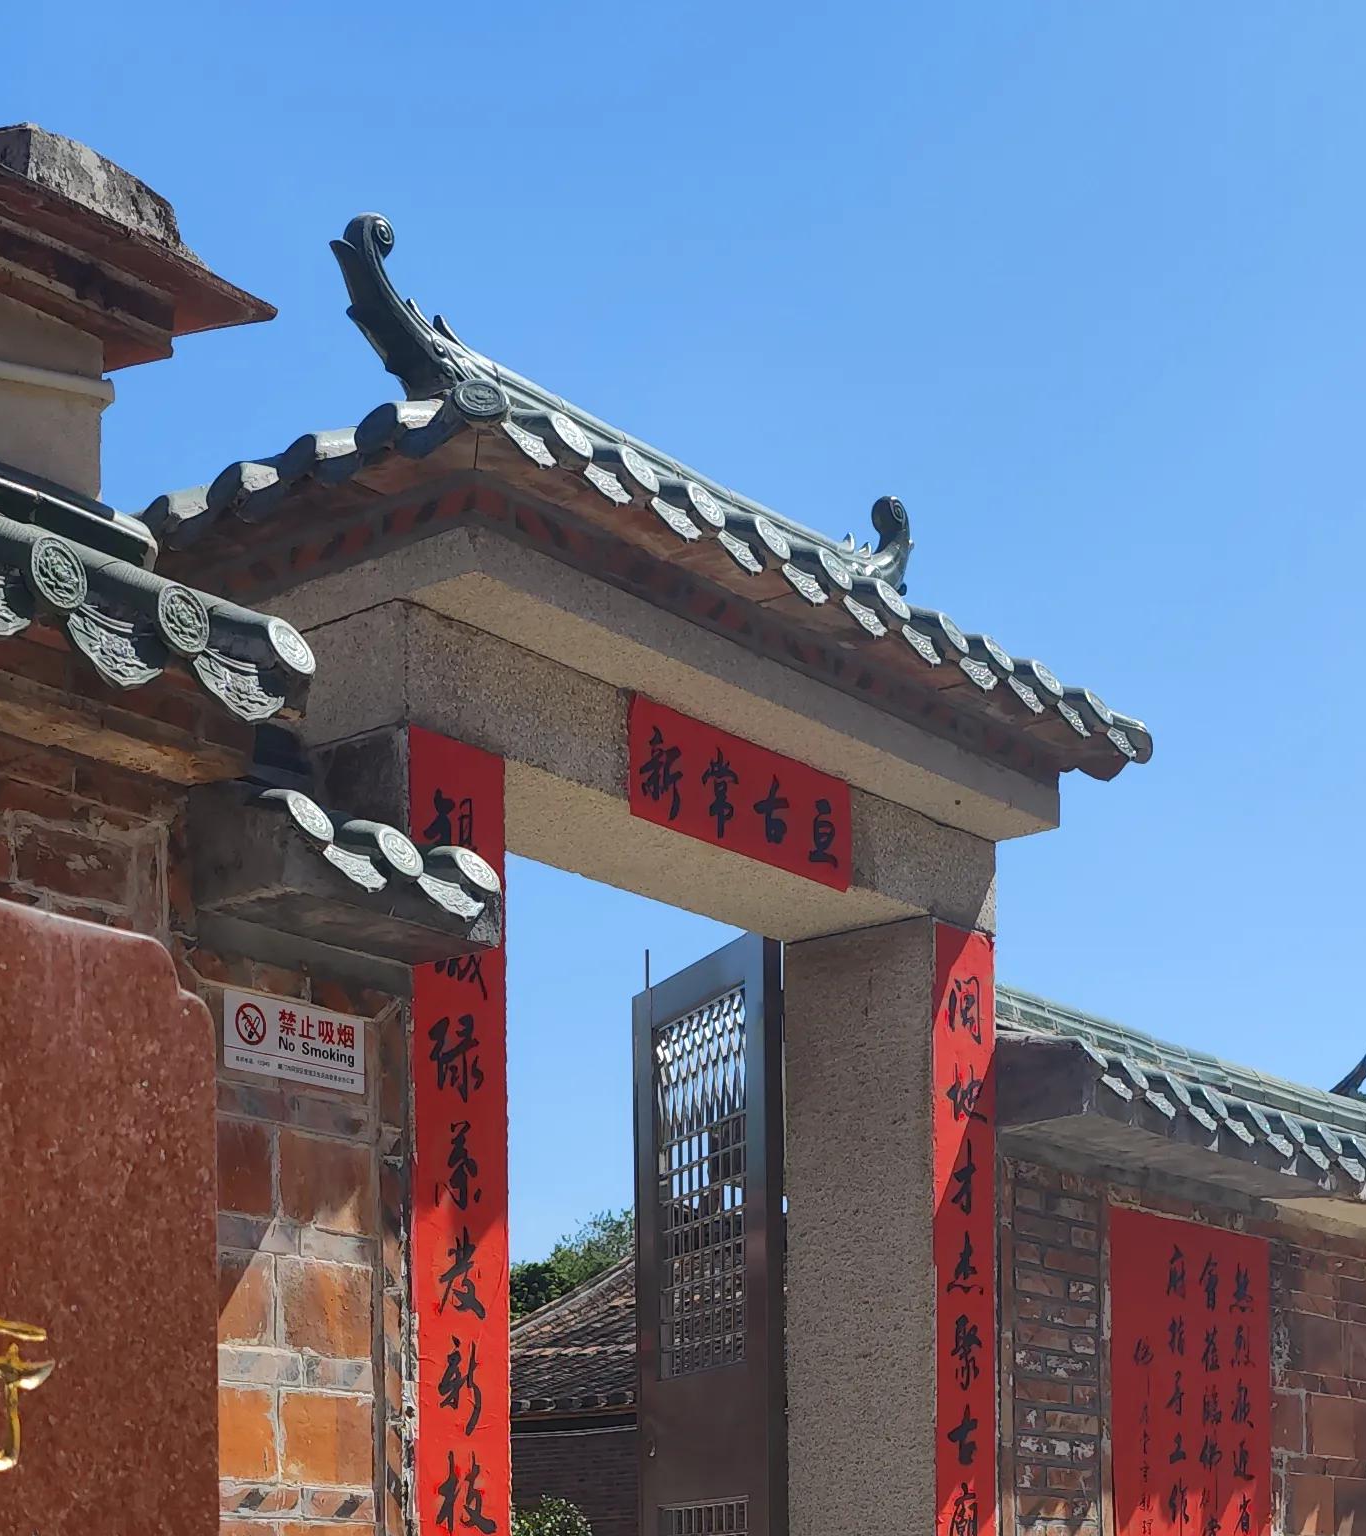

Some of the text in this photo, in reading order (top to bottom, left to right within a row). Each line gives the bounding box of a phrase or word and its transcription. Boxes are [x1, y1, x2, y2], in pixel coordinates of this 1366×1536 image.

[278, 1009, 355, 1050] 禁止吸烟
[278, 1036, 355, 1068] No Smoking
